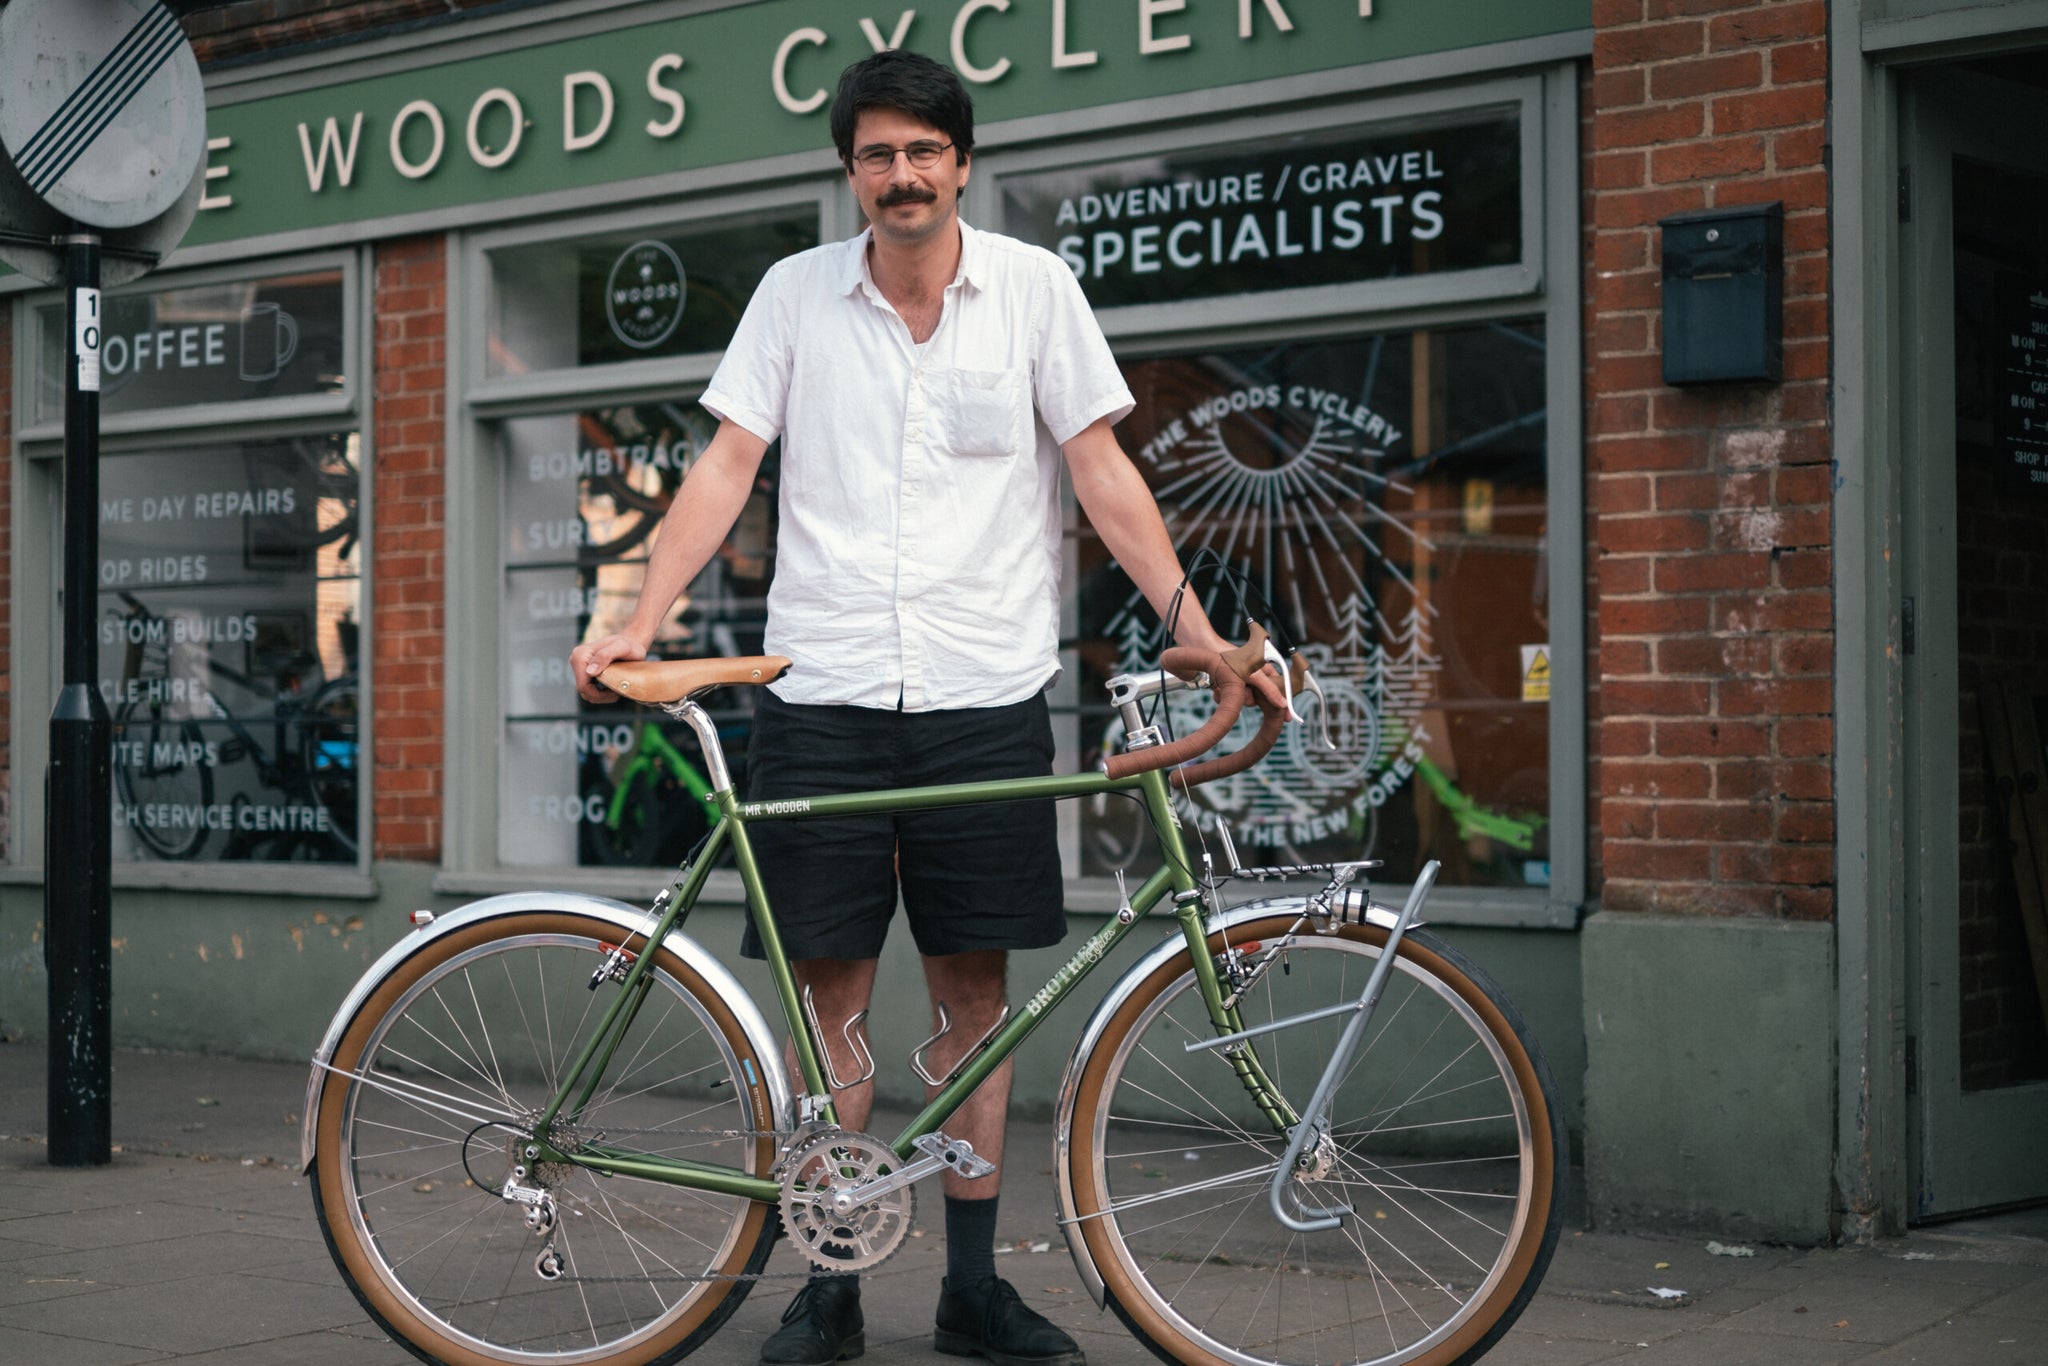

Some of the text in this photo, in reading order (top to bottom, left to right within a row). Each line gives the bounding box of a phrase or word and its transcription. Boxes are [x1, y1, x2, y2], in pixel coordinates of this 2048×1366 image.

[297, 53, 686, 193] WOODS
[772, 0, 1371, 113] CCLE
[1055, 172, 1264, 226] ADVENTURE
[1298, 150, 1444, 194] GRAVEL
[1056, 190, 1444, 280] SPECIALISTS
[613, 282, 679, 305] WOODS
[2031, 321, 2048, 335] SHO
[103, 324, 225, 375] OFFEE
[2031, 381, 2048, 394] CAF
[1140, 384, 1402, 464] THE WOODS CYCLERY
[2014, 450, 2040, 465] SHOP
[101, 487, 296, 524] ME DAY REPAIRS
[140, 554, 208, 583] RIDES
[102, 615, 257, 645] STOM BUILDS
[99, 677, 201, 704] CLE HIRE
[152, 740, 218, 767] MAPS
[528, 722, 634, 756] RONDO
[1240, 723, 1431, 847] THE NEW FOREST
[145, 803, 233, 830] SERVICE
[240, 805, 330, 833] CENTRE
[528, 793, 606, 825] FROG
[745, 800, 810, 816] MR WOODEN
[1025, 935, 1099, 1018] BROTHER
